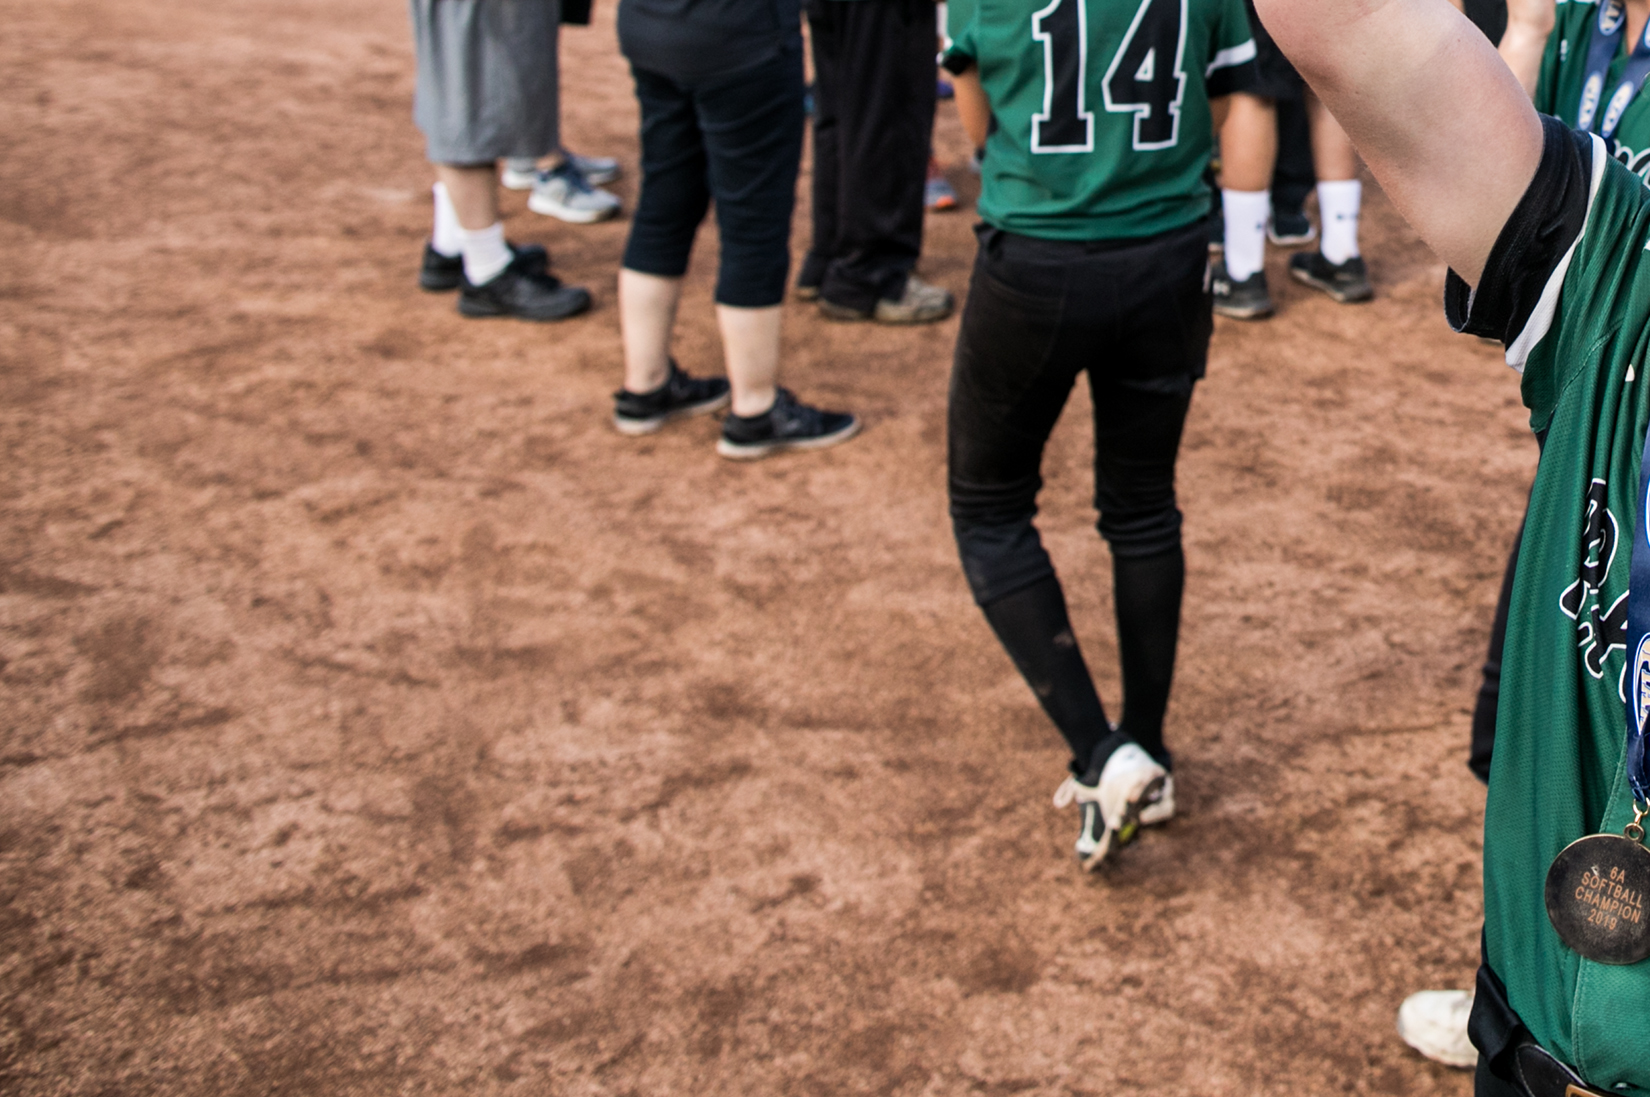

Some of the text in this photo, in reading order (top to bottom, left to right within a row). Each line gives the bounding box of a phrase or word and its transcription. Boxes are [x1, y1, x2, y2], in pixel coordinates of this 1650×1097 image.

[1581, 871, 1643, 909] SOFTBALL
[1610, 866, 1625, 884] 6A
[1574, 886, 1642, 924] CHAMPION
[1587, 908, 1618, 931] 2019
